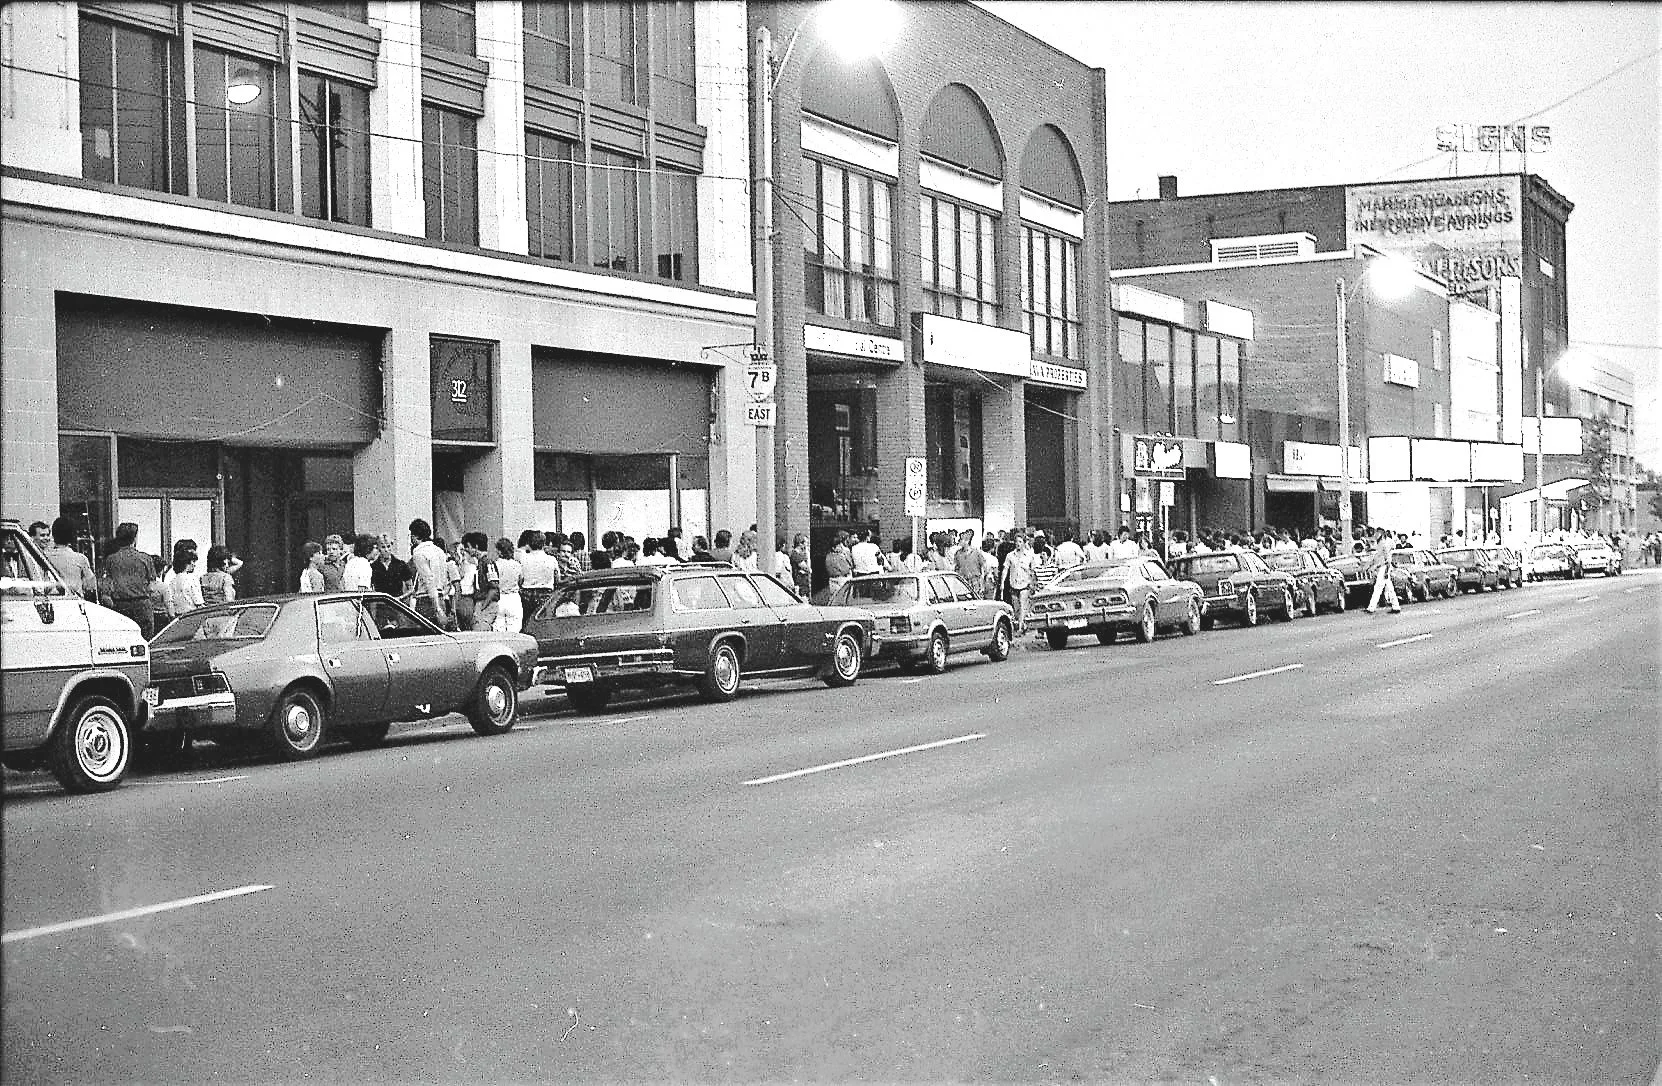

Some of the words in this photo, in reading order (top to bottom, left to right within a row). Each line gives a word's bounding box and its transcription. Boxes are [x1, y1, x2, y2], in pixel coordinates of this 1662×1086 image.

[1436, 123, 1551, 153] SIGNS
[451, 379, 467, 398] 312
[748, 408, 770, 420] EAST
